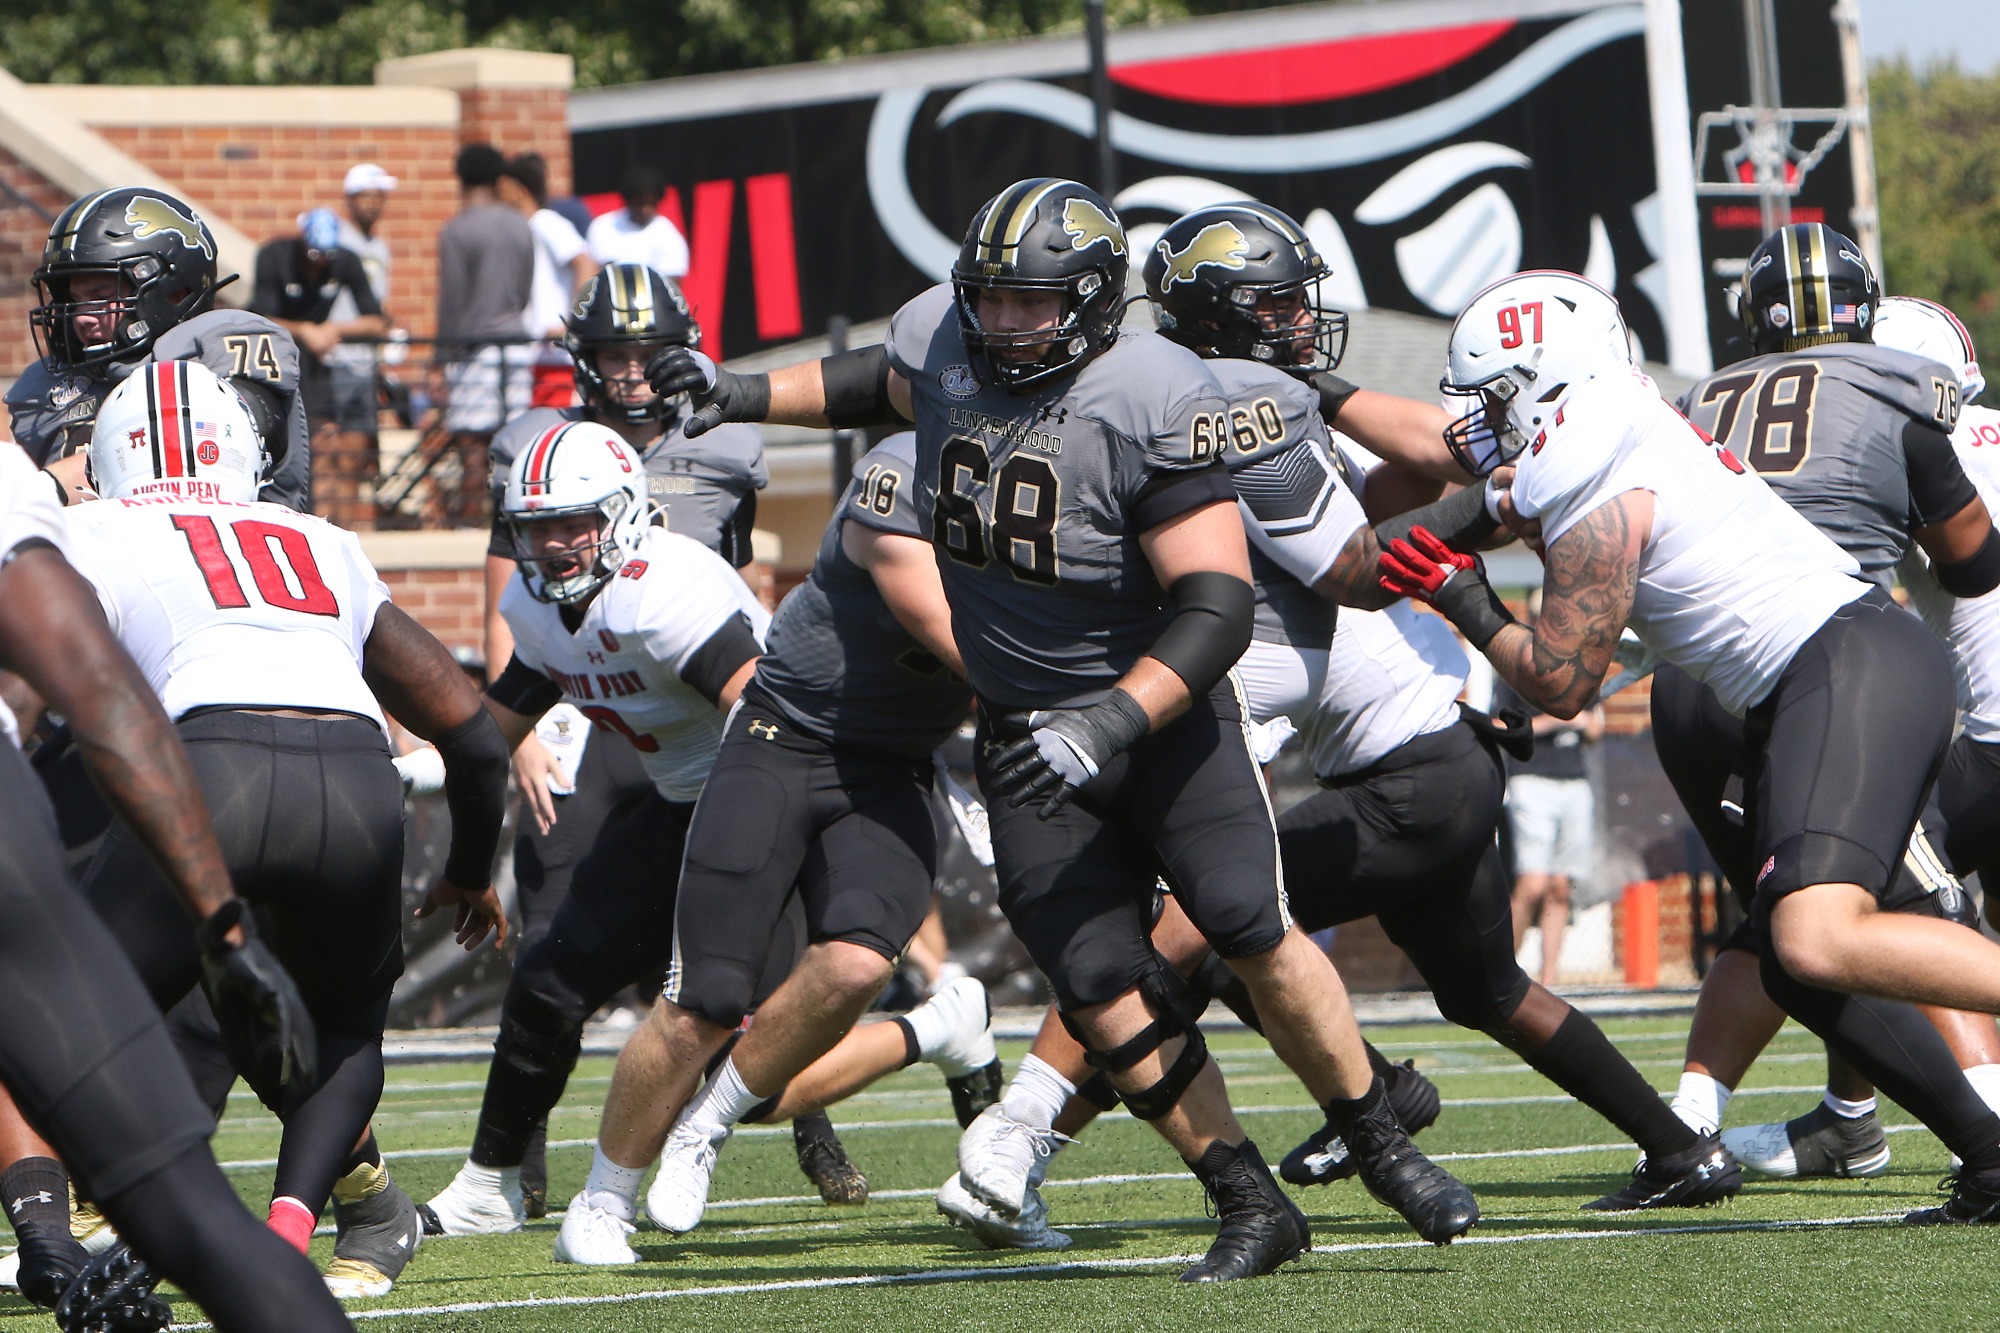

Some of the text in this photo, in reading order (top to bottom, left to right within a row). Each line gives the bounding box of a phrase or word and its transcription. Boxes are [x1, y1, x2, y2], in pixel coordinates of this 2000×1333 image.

[1497, 301, 1544, 349] 97
[223, 334, 282, 382] 74
[945, 373, 976, 392] OVC
[1931, 376, 1958, 427] 78
[949, 407, 1063, 454] LINDENWOOD
[1190, 411, 1229, 462] 68
[1228, 396, 1286, 456] 60
[1698, 361, 1824, 477] 78
[1969, 421, 2000, 448] JO
[201, 444, 216, 461] JC
[605, 439, 632, 474] 9
[187, 480, 221, 499] PEAY
[855, 462, 902, 518] 18
[932, 433, 1062, 588] 68
[169, 513, 340, 618] 10
[596, 670, 647, 698] PEAY
